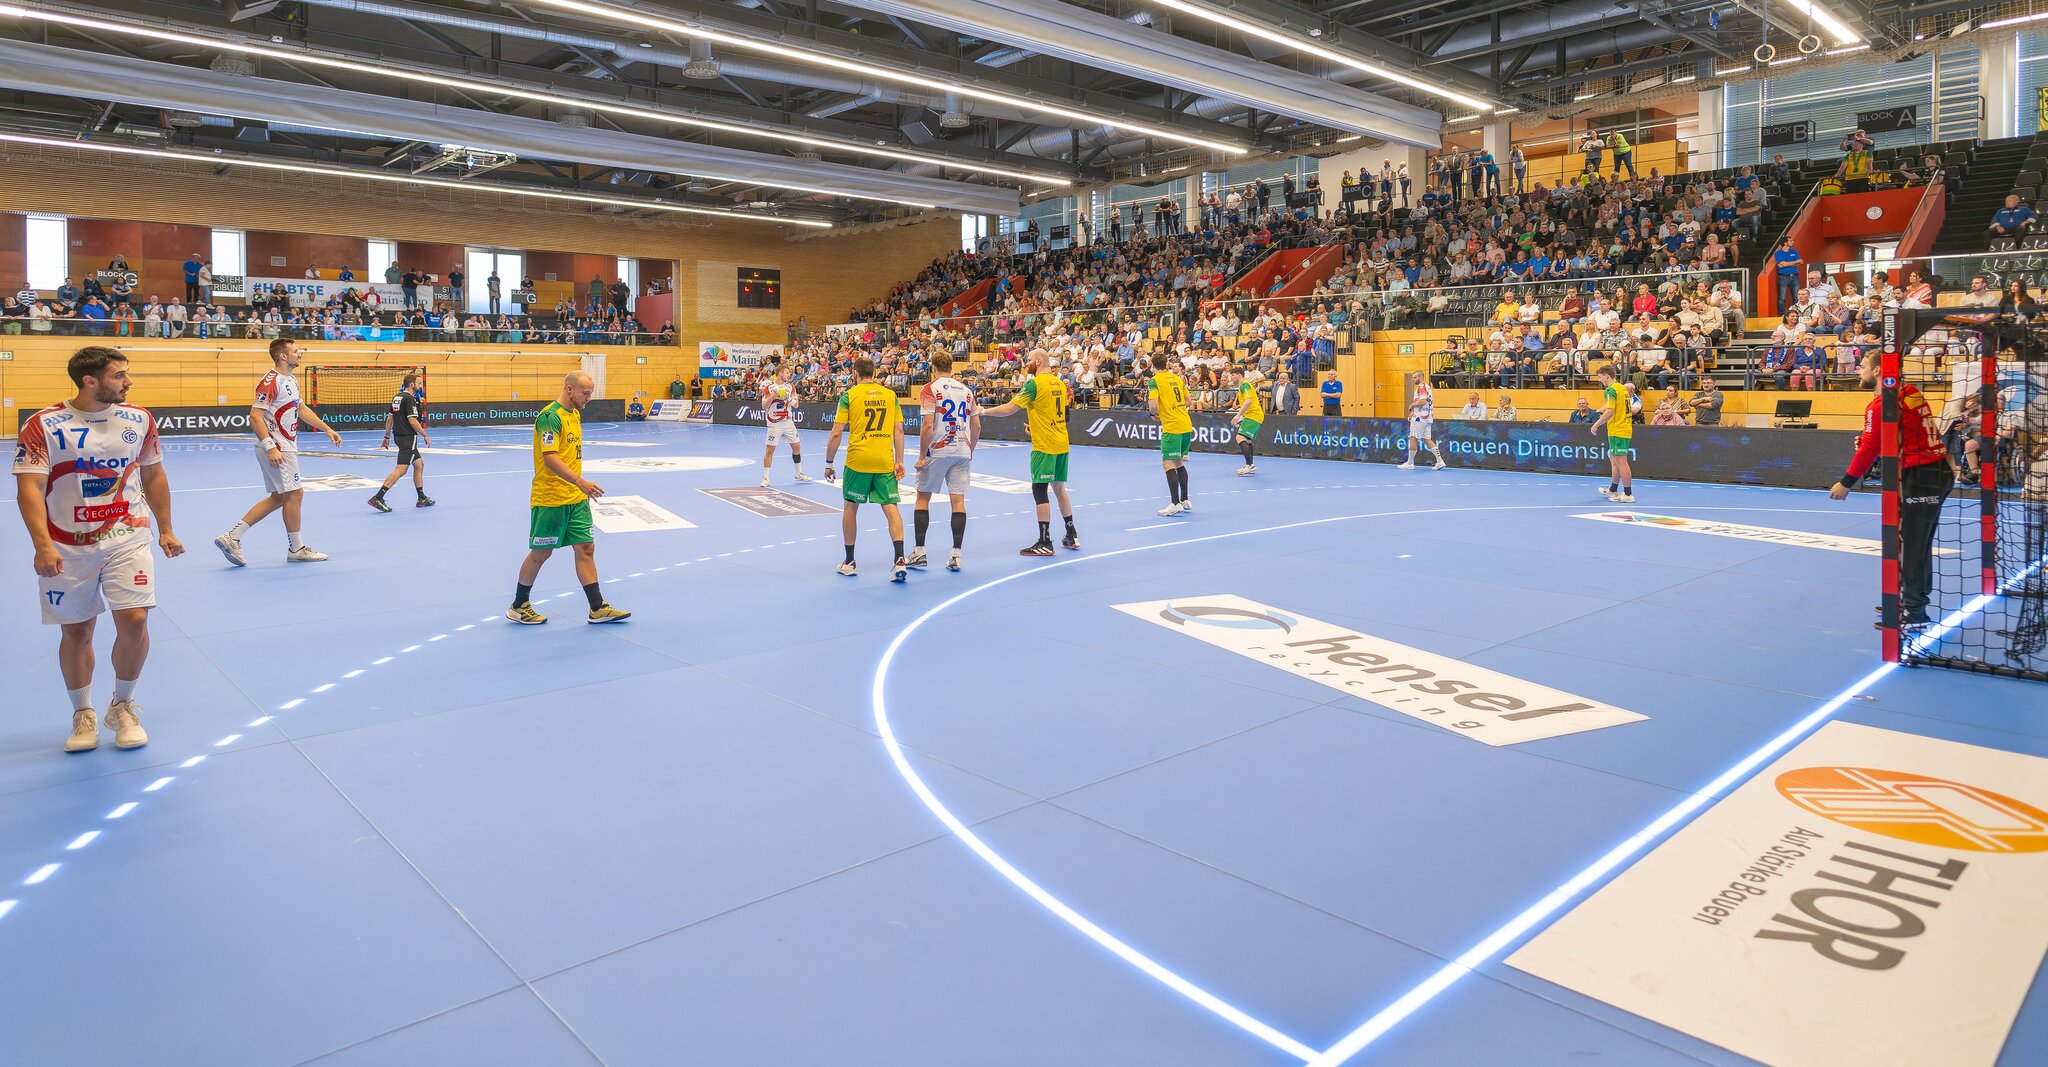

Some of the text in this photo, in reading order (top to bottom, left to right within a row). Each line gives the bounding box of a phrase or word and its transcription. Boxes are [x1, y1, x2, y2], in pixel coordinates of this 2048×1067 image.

[1858, 108, 1915, 128] BLOCK A
[1762, 124, 1808, 141] BLOCK B
[1308, 192, 1317, 205] D
[1344, 185, 1372, 198] BLOCK C
[1063, 226, 1069, 237] E
[98, 270, 138, 286] BLOCK G
[219, 275, 243, 284] STEH-
[526, 293, 537, 304] G
[732, 355, 760, 365] Main-
[285, 385, 292, 396] 5
[1173, 386, 1181, 403] 9
[321, 411, 389, 424] Autowäsch
[450, 410, 486, 420] neuen
[489, 408, 539, 419] Dimensio
[941, 398, 967, 423] 24
[155, 415, 250, 429] ATERWO
[864, 407, 887, 431] 27
[52, 427, 90, 450] 17
[1115, 422, 1232, 444] WATEORLD
[1274, 429, 1369, 449] Autowäsche
[1375, 434, 1390, 450] in
[1449, 438, 1510, 456] neuen
[1518, 439, 1637, 462] Dimensin
[294, 473, 299, 481] 5
[46, 590, 65, 605] 17
[1283, 635, 1595, 722] hensel
[1247, 646, 1486, 729] recycling
[1692, 826, 1824, 925] Auf Stärke Bauen
[1753, 840, 1969, 971] THOR
